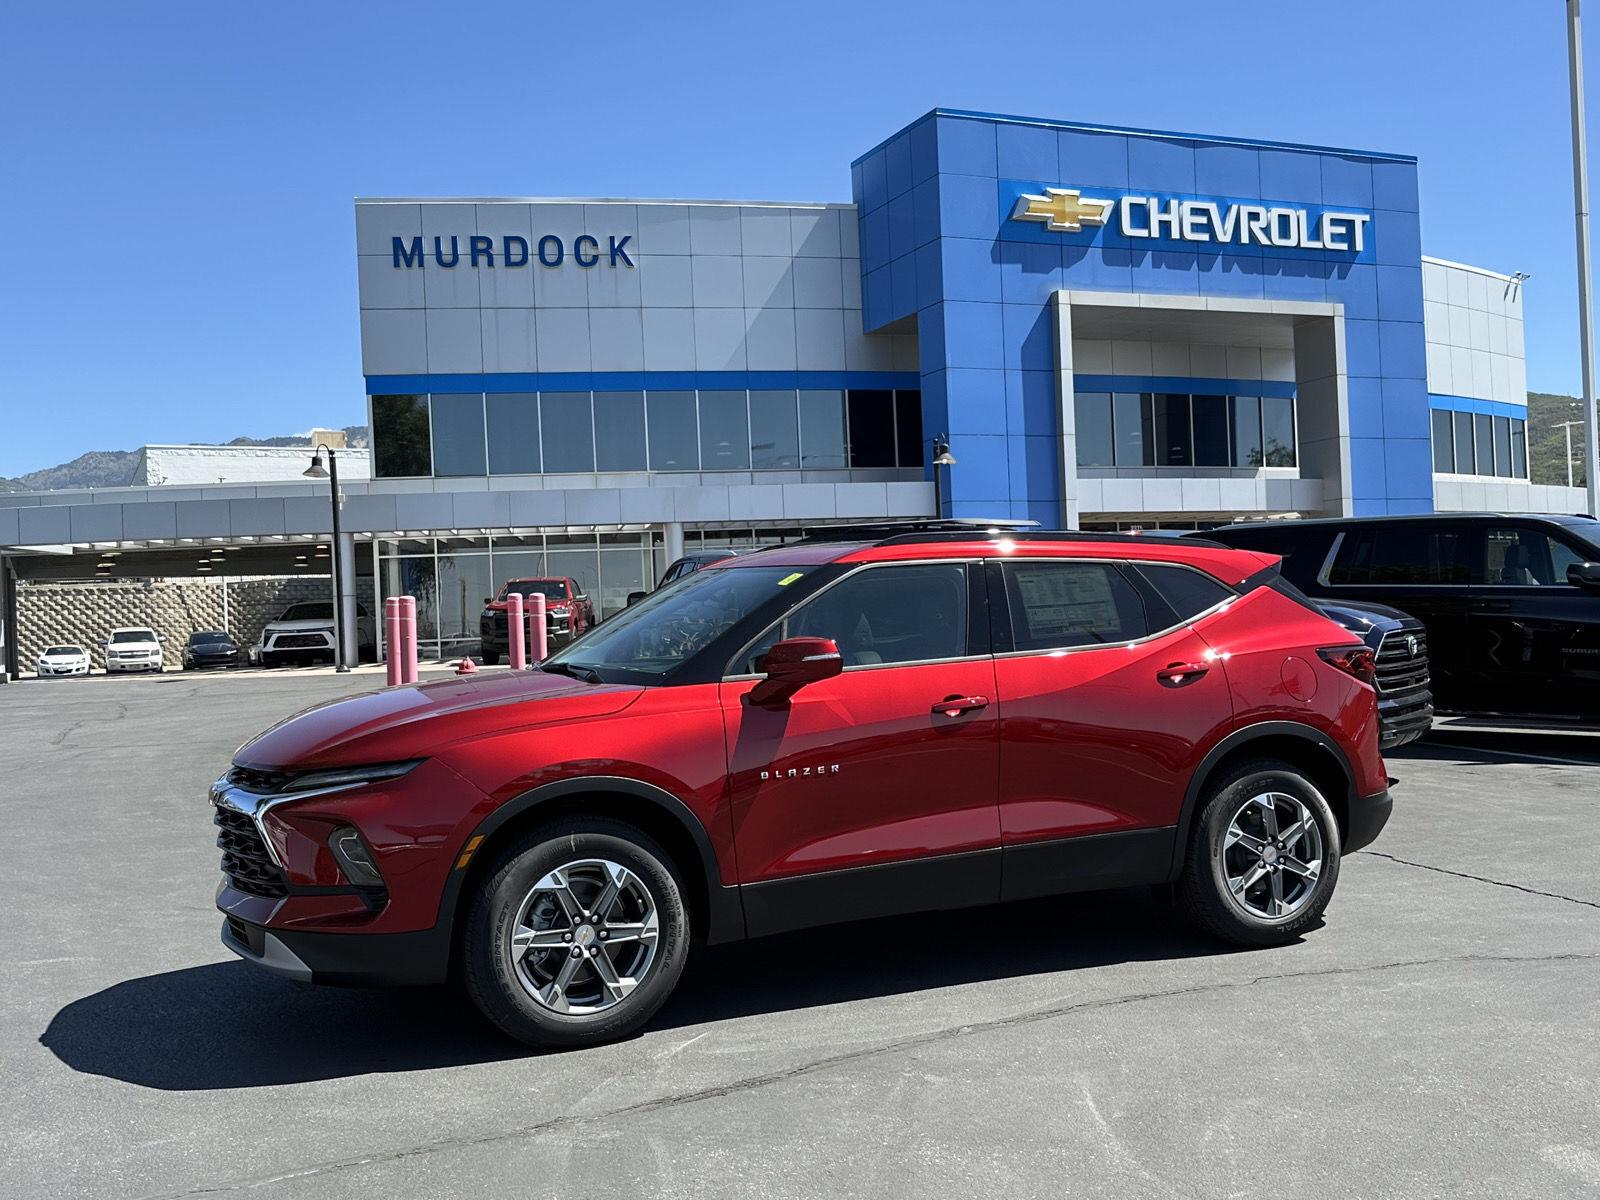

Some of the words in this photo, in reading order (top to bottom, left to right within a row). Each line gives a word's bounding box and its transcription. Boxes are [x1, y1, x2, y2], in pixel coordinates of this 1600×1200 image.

[1120, 196, 1370, 252] CHEVROLET
[391, 234, 636, 268] MURDOCK
[761, 764, 839, 779] BLAZER
